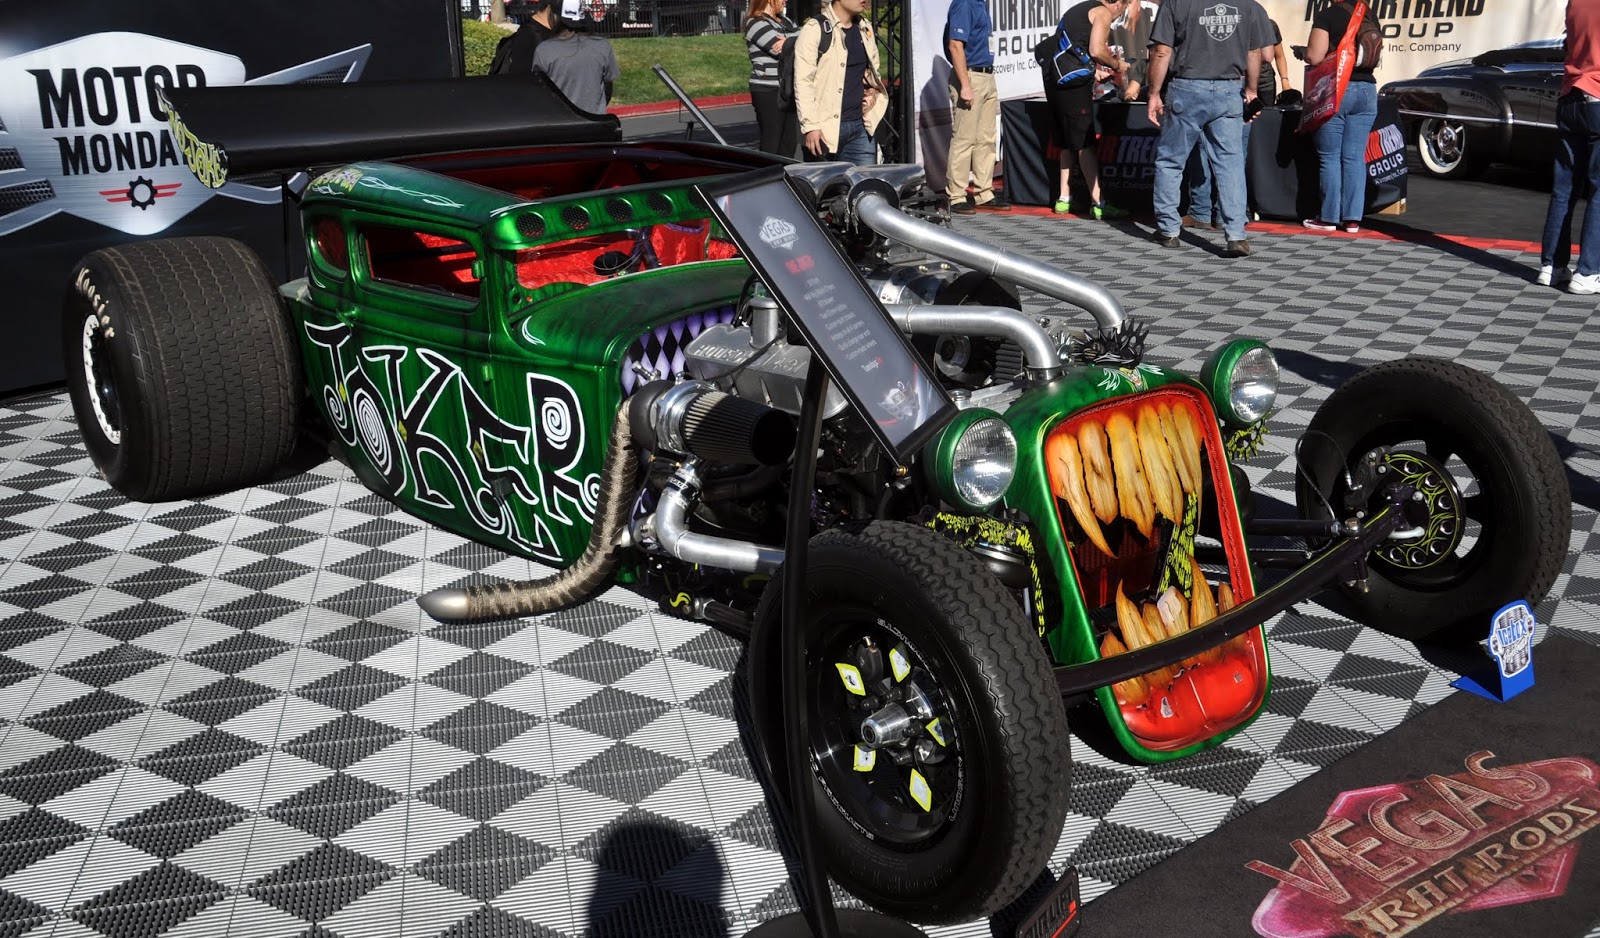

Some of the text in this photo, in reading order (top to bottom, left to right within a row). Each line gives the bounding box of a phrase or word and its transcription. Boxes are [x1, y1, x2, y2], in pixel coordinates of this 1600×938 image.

[1199, 15, 1242, 25] OVERTIME
[1210, 25, 1233, 34] FAB
[1380, 22, 1454, 38] OUP
[1388, 42, 1462, 53] Inc. Company
[992, 62, 1016, 75] scovery
[53, 130, 188, 176] MONDA
[1369, 153, 1404, 177] GROUP
[761, 219, 791, 239] VEGAS
[304, 320, 602, 562] JOKER
[1244, 750, 1551, 904] VEGAS
[1369, 797, 1598, 932] RAT RODS
